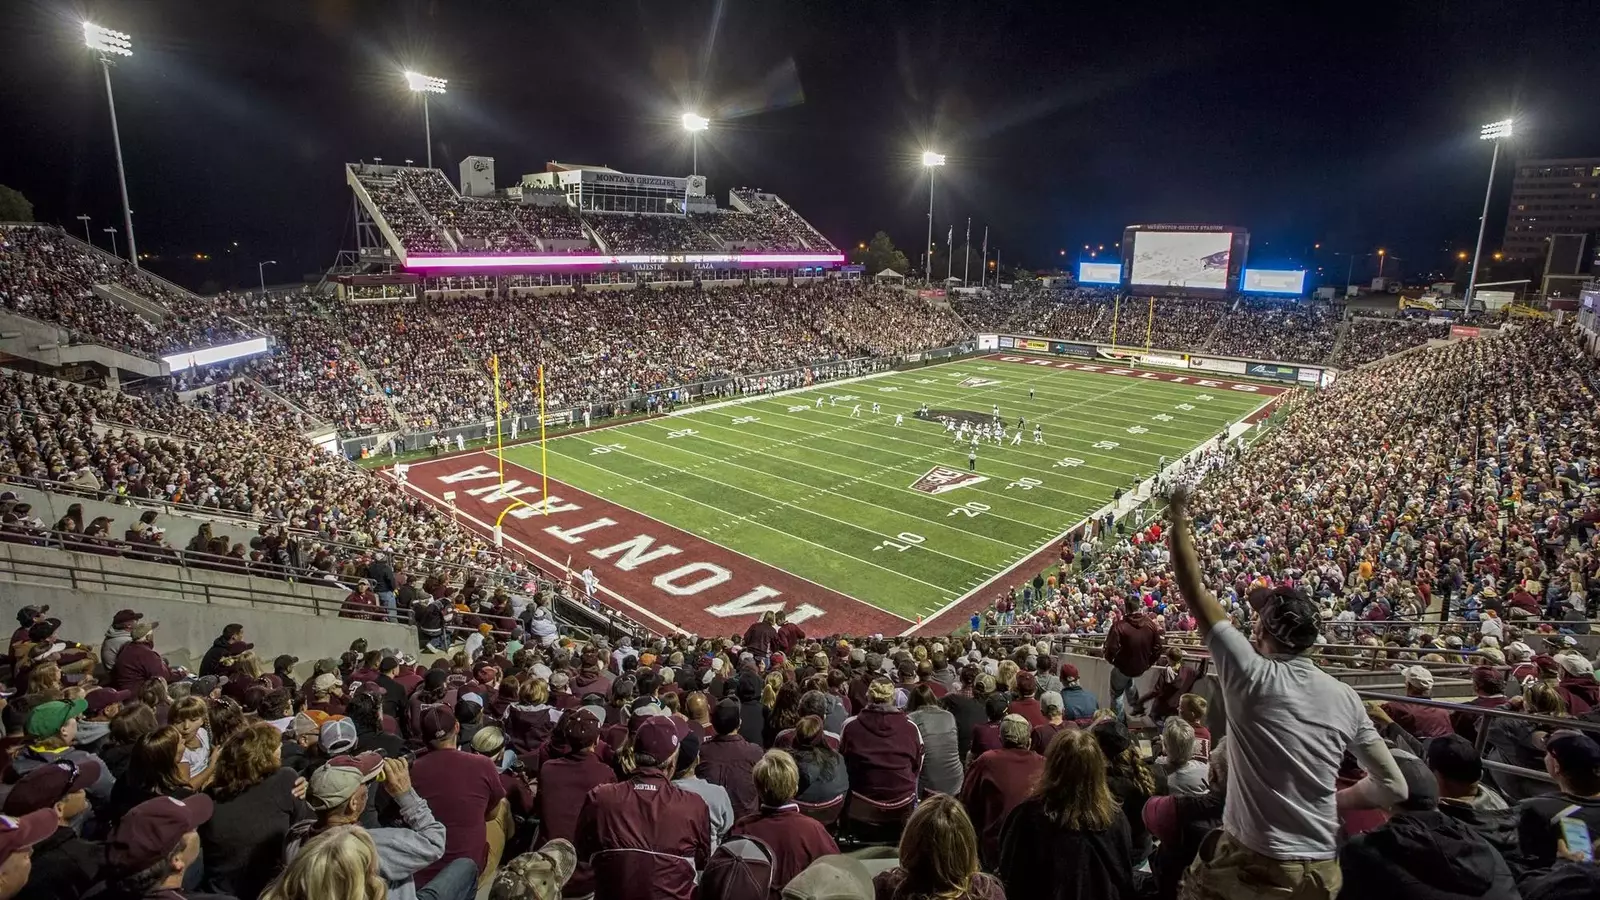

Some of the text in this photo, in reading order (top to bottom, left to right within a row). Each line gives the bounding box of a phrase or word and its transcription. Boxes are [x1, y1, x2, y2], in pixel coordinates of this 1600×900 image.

[596, 174, 676, 187] MONTANA GRIZZLIES
[1000, 356, 1260, 392] GRIZZLIES
[599, 443, 627, 455] 10
[1057, 457, 1086, 467] 40
[1009, 477, 1043, 490] 30
[952, 502, 991, 518] 20
[438, 465, 827, 625] MONTANA
[883, 532, 927, 552] 10
